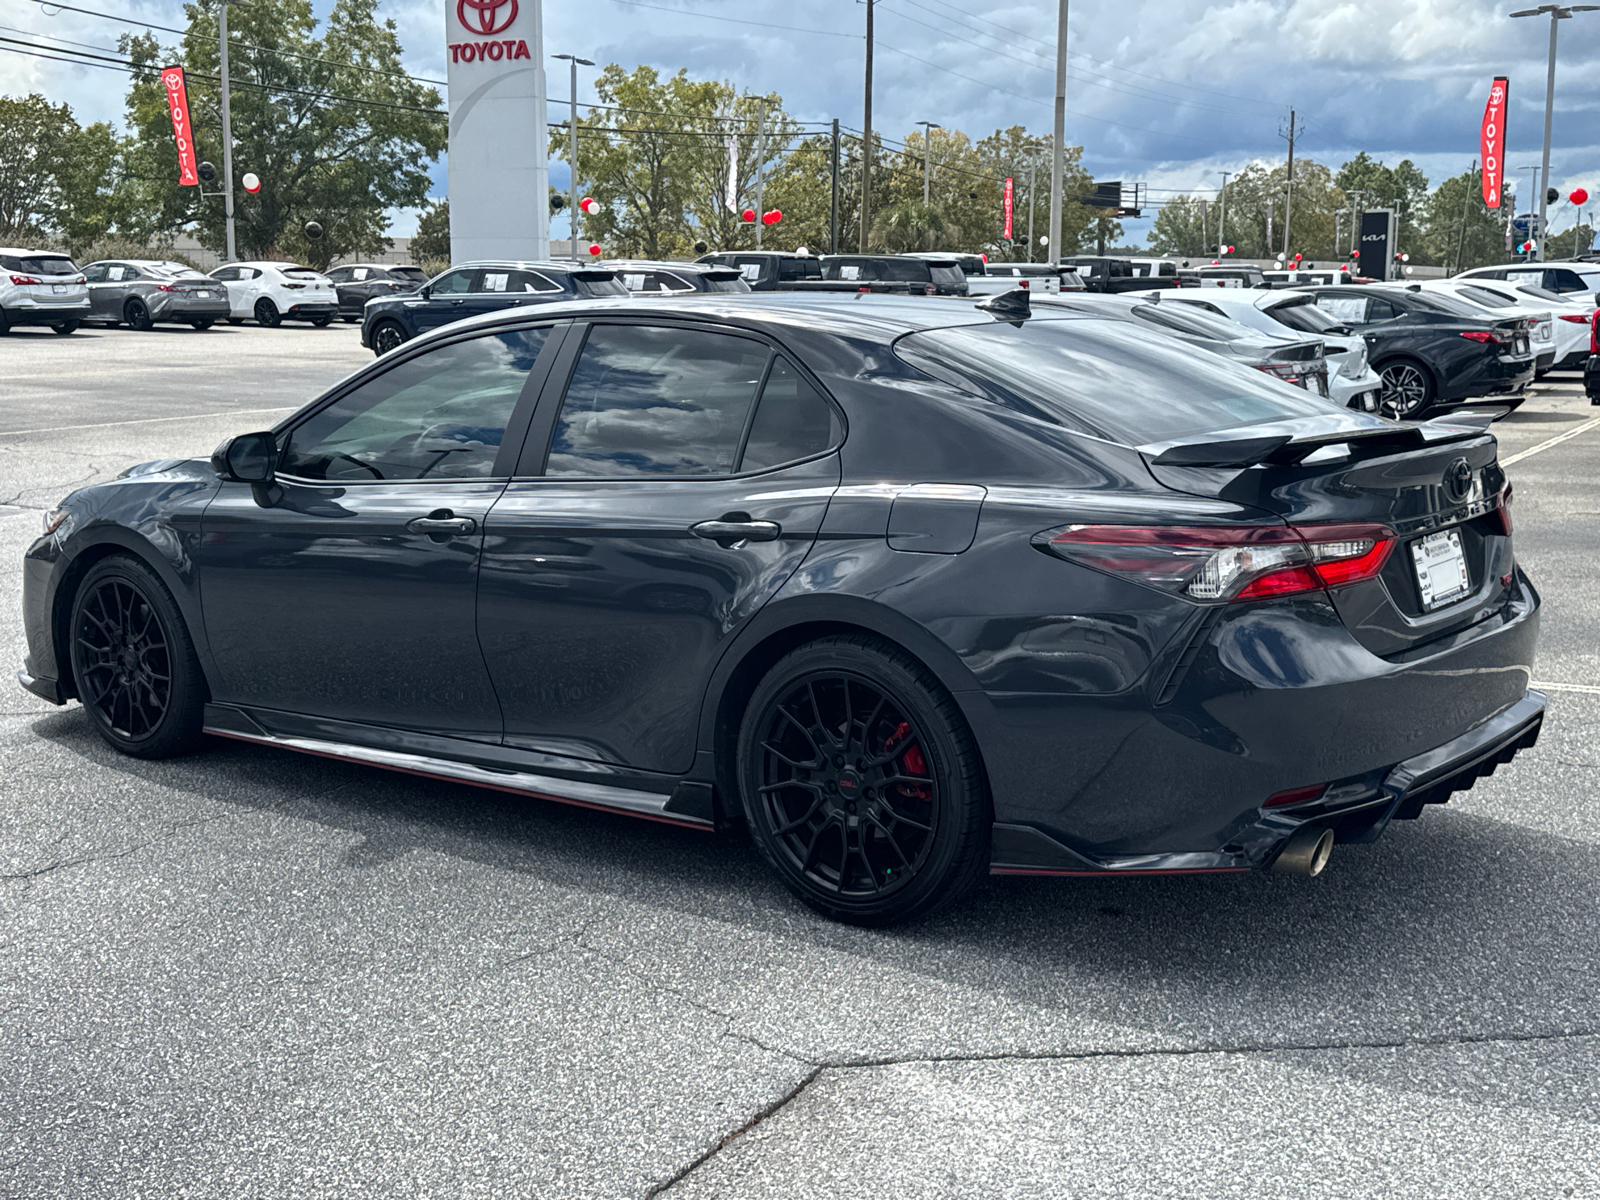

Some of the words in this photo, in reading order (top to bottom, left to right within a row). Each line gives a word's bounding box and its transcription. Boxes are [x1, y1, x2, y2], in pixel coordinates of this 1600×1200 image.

[448, 39, 531, 63] TOYOTA
[171, 92, 194, 181] TOYOTA
[1485, 107, 1498, 203] TOYOTA
